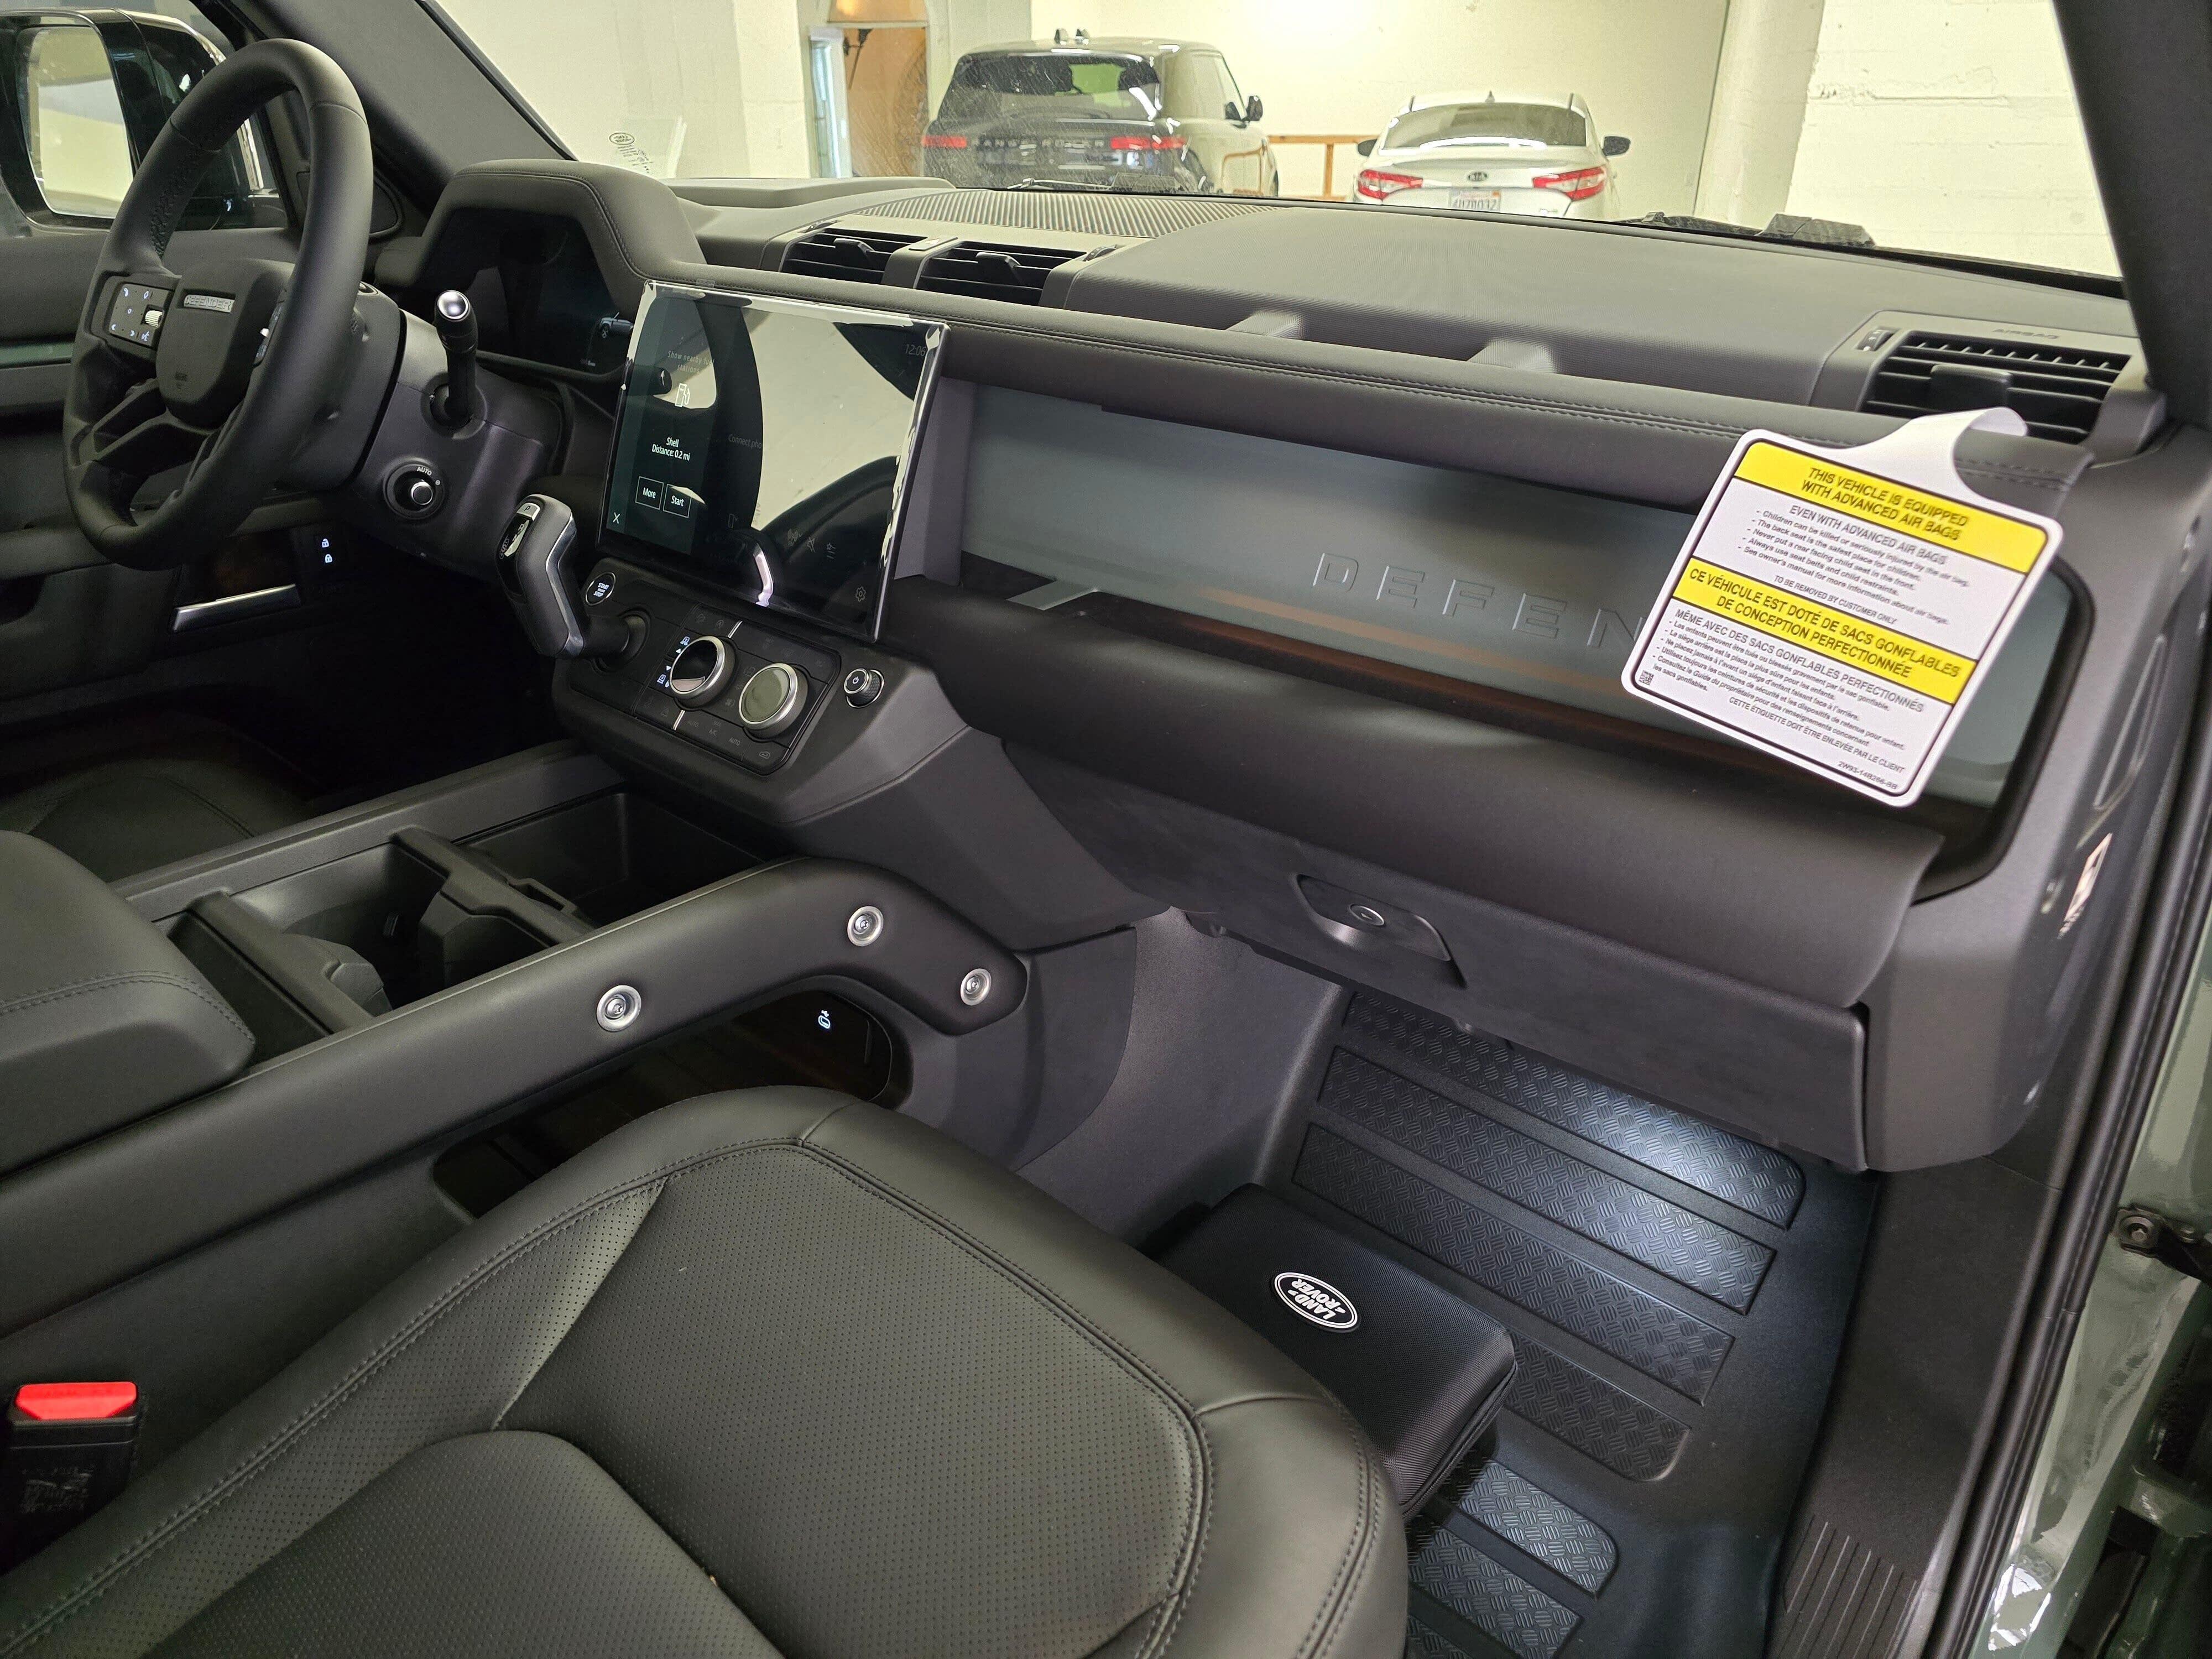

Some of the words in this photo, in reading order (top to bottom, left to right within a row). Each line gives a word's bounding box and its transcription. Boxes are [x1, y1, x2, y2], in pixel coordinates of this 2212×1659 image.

[185, 295, 232, 310] DEFENDER
[651, 444, 674, 457] Distance:
[674, 450, 683, 459] 0.2
[683, 452, 691, 461] mi
[666, 437, 679, 447] Shell
[417, 467, 432, 476] AUTO
[643, 487, 656, 498] More
[671, 495, 684, 507] Start
[1801, 479, 1833, 498] WITH
[1831, 491, 1899, 520] ADVANCED
[1898, 513, 1923, 528] AIR
[1923, 520, 1961, 540] BAGS
[1808, 467, 1836, 484] THIS
[1837, 476, 1889, 501] VEHICLE
[1887, 493, 1903, 505] IS
[1902, 498, 1969, 526] EQUIPPED
[1752, 528, 1775, 540] Never
[1773, 537, 1788, 546] put
[1793, 544, 1810, 552] rear
[1809, 548, 1834, 563] facing
[1833, 558, 1854, 568] child
[1853, 565, 1871, 575] seat
[1757, 519, 1771, 529] The
[1771, 524, 1791, 535] back
[1790, 531, 1807, 541] seat
[1828, 545, 1853, 557] safest
[1850, 553, 1874, 565] place
[1762, 510, 1793, 526] Children
[1793, 522, 1808, 531] can
[1808, 526, 1819, 535] be
[1818, 529, 1841, 542] killed
[1849, 541, 1886, 559] seriously
[1788, 504, 1817, 521] EVEN
[1816, 513, 1843, 530] WITH
[1841, 523, 1898, 548] ADVANCED
[1896, 541, 1917, 555] AIR
[1916, 547, 1948, 565] BAGS
[1747, 538, 1775, 551] Always
[1774, 547, 1788, 556] use
[1788, 552, 1806, 562] seat
[1805, 557, 1825, 569] belts
[1840, 571, 1861, 582] child
[1774, 575, 1784, 583] TO
[1783, 578, 1795, 587] BE
[1793, 582, 1828, 599] REMOVED
[1827, 594, 1839, 603] BY
[1838, 598, 1877, 618] CUSTOMER
[1689, 568, 1707, 582] CE
[1707, 573, 1764, 604] VÉHICULE
[1762, 595, 1788, 613] EST
[1786, 604, 1822, 625] DOTÉ
[1820, 617, 1840, 632] DE
[1839, 624, 1874, 645] SACS
[1875, 638, 1961, 677] GONFLABLES
[1716, 595, 1735, 610] DE
[1734, 602, 1811, 639] CONCEPTION
[1809, 630, 1912, 678] PERFECTIONNÉE
[1674, 608, 1703, 626] MÊME
[1702, 620, 1728, 635] AVEC
[1728, 629, 1749, 644] DES
[1748, 637, 1775, 654] SACS
[1775, 648, 1840, 680] GONFLABLES
[1839, 673, 1924, 712] PERFECTIONNÉS
[728, 737, 740, 746] AUTO
[1729, 696, 1751, 710] CETTE
[1749, 704, 1787, 725] ÉTIQUETTE
[1786, 720, 1804, 731] DOIT
[1820, 734, 1854, 753] ENLEVÉE
[1852, 748, 1869, 759] PAR
[1867, 754, 1879, 763] LE
[1878, 758, 1905, 773] CLIENT
[1292, 1279, 1341, 1309] ROVER
[1295, 1294, 1336, 1319] LAND
